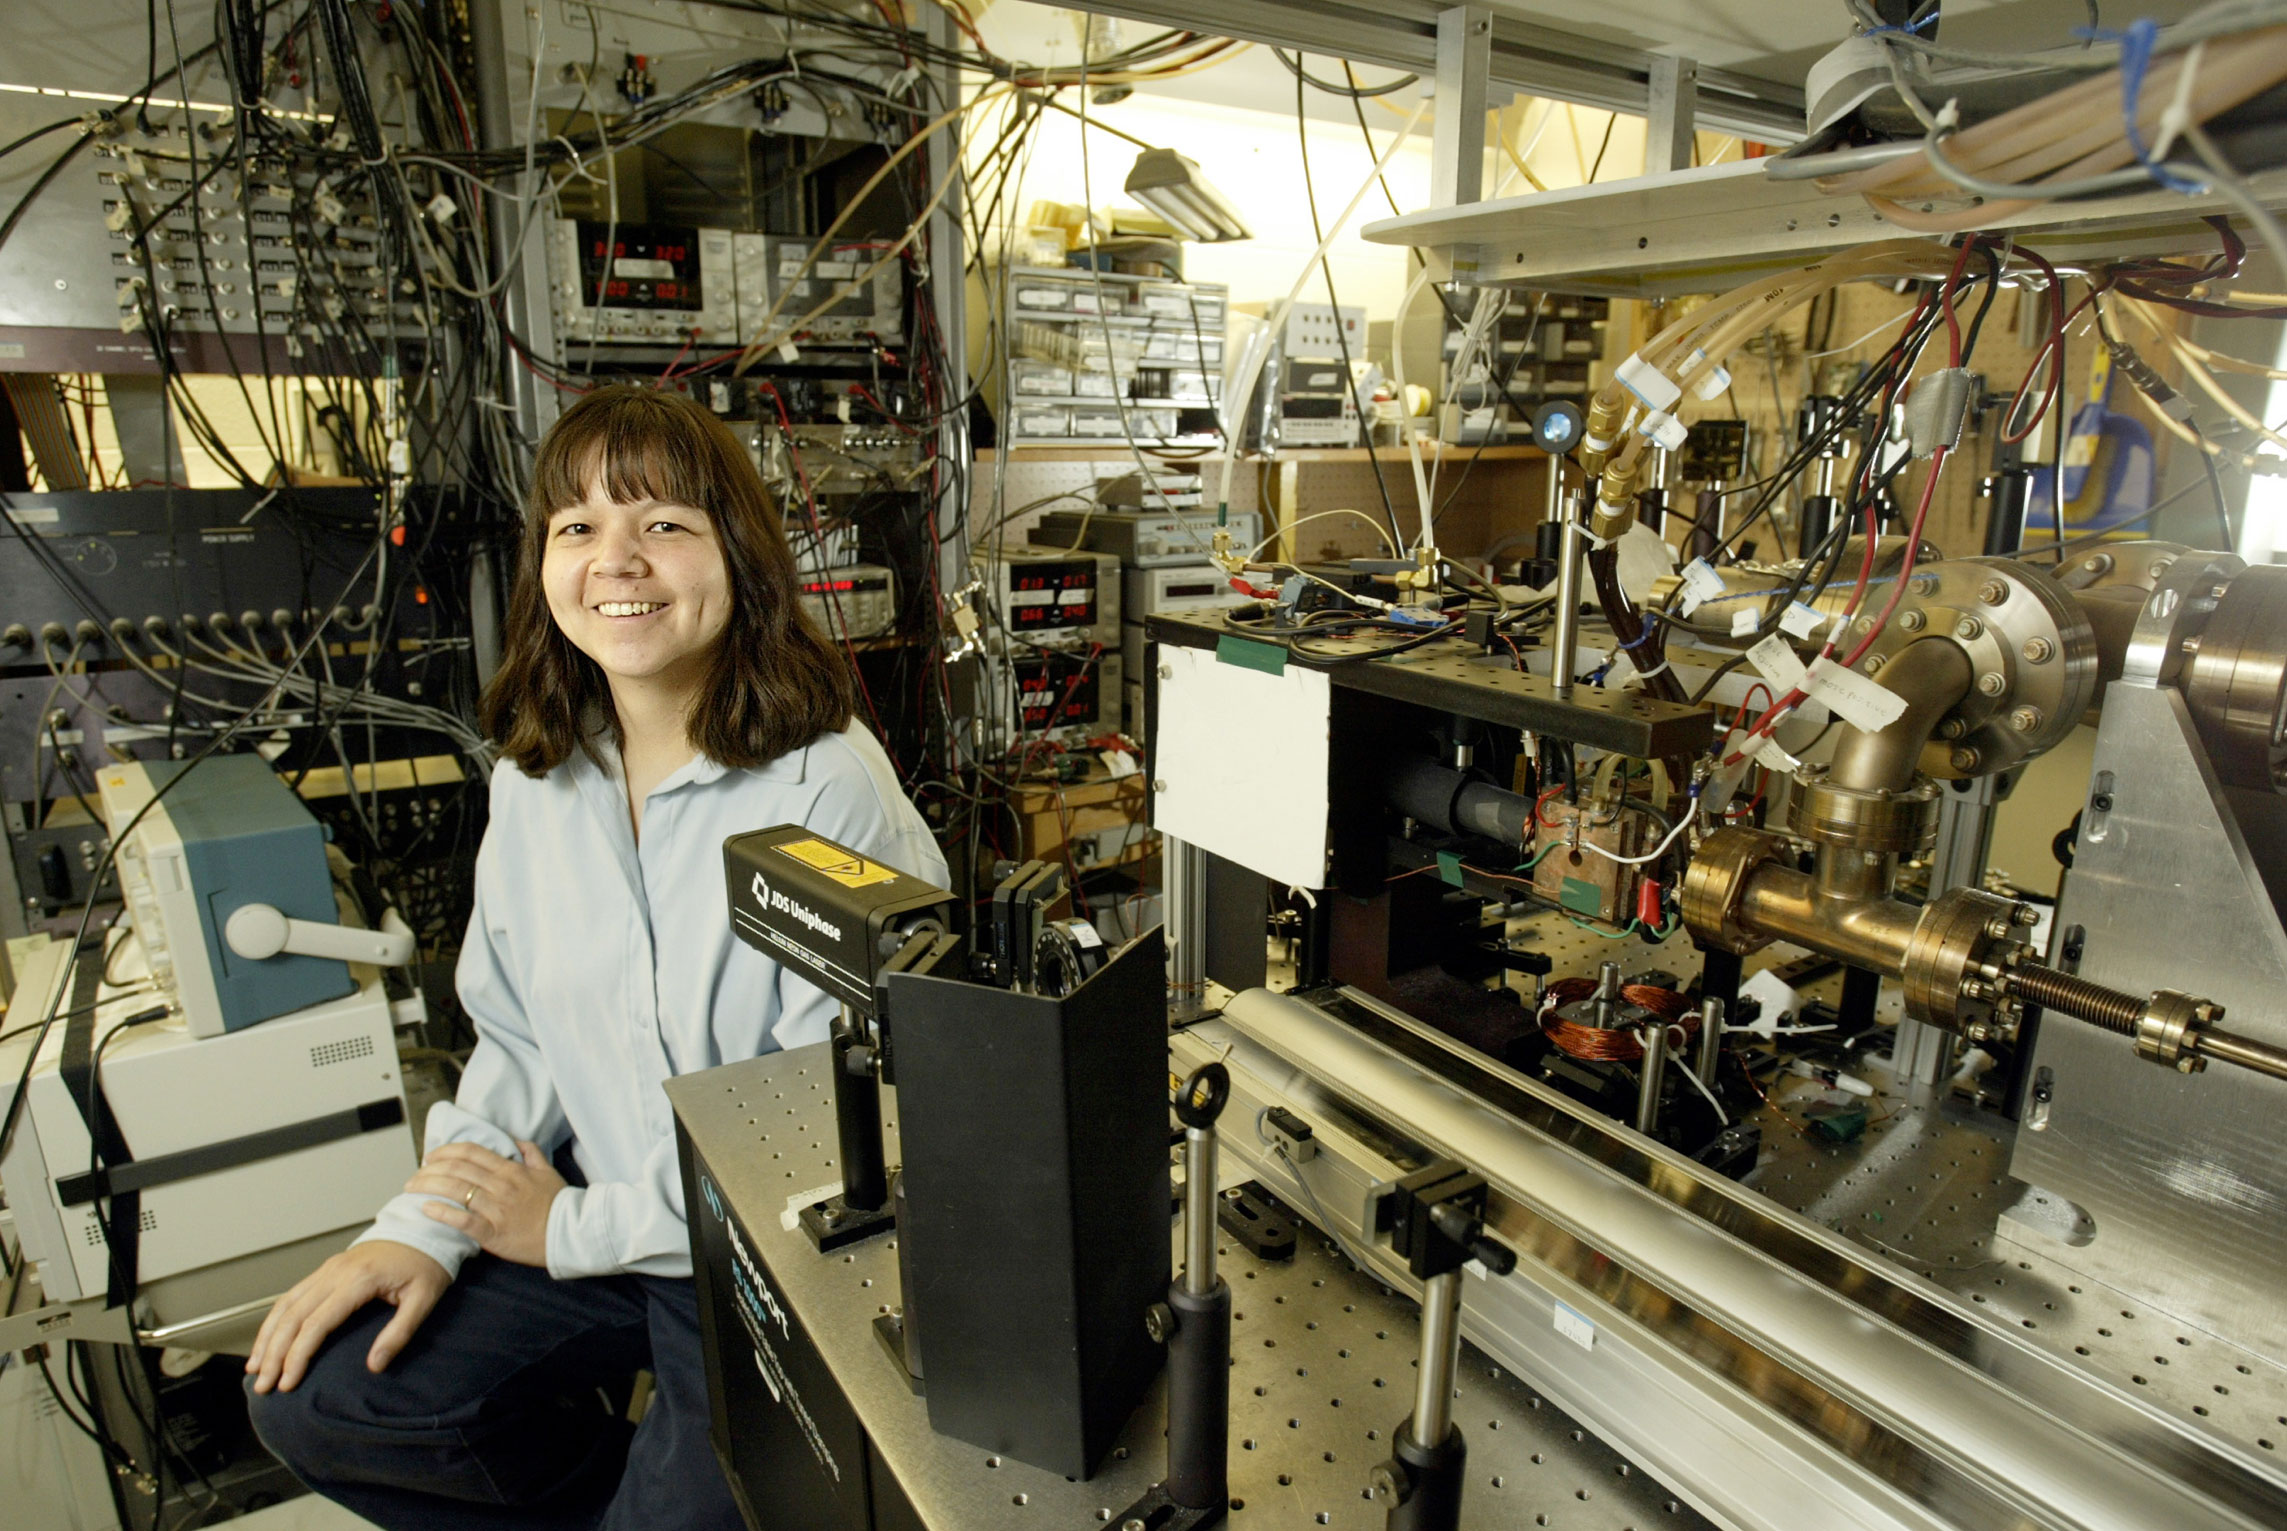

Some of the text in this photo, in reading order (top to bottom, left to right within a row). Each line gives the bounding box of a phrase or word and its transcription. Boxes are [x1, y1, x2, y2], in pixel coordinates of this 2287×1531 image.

[770, 890, 841, 942] JDS Uniphase
[726, 1215, 790, 1341] Newport
